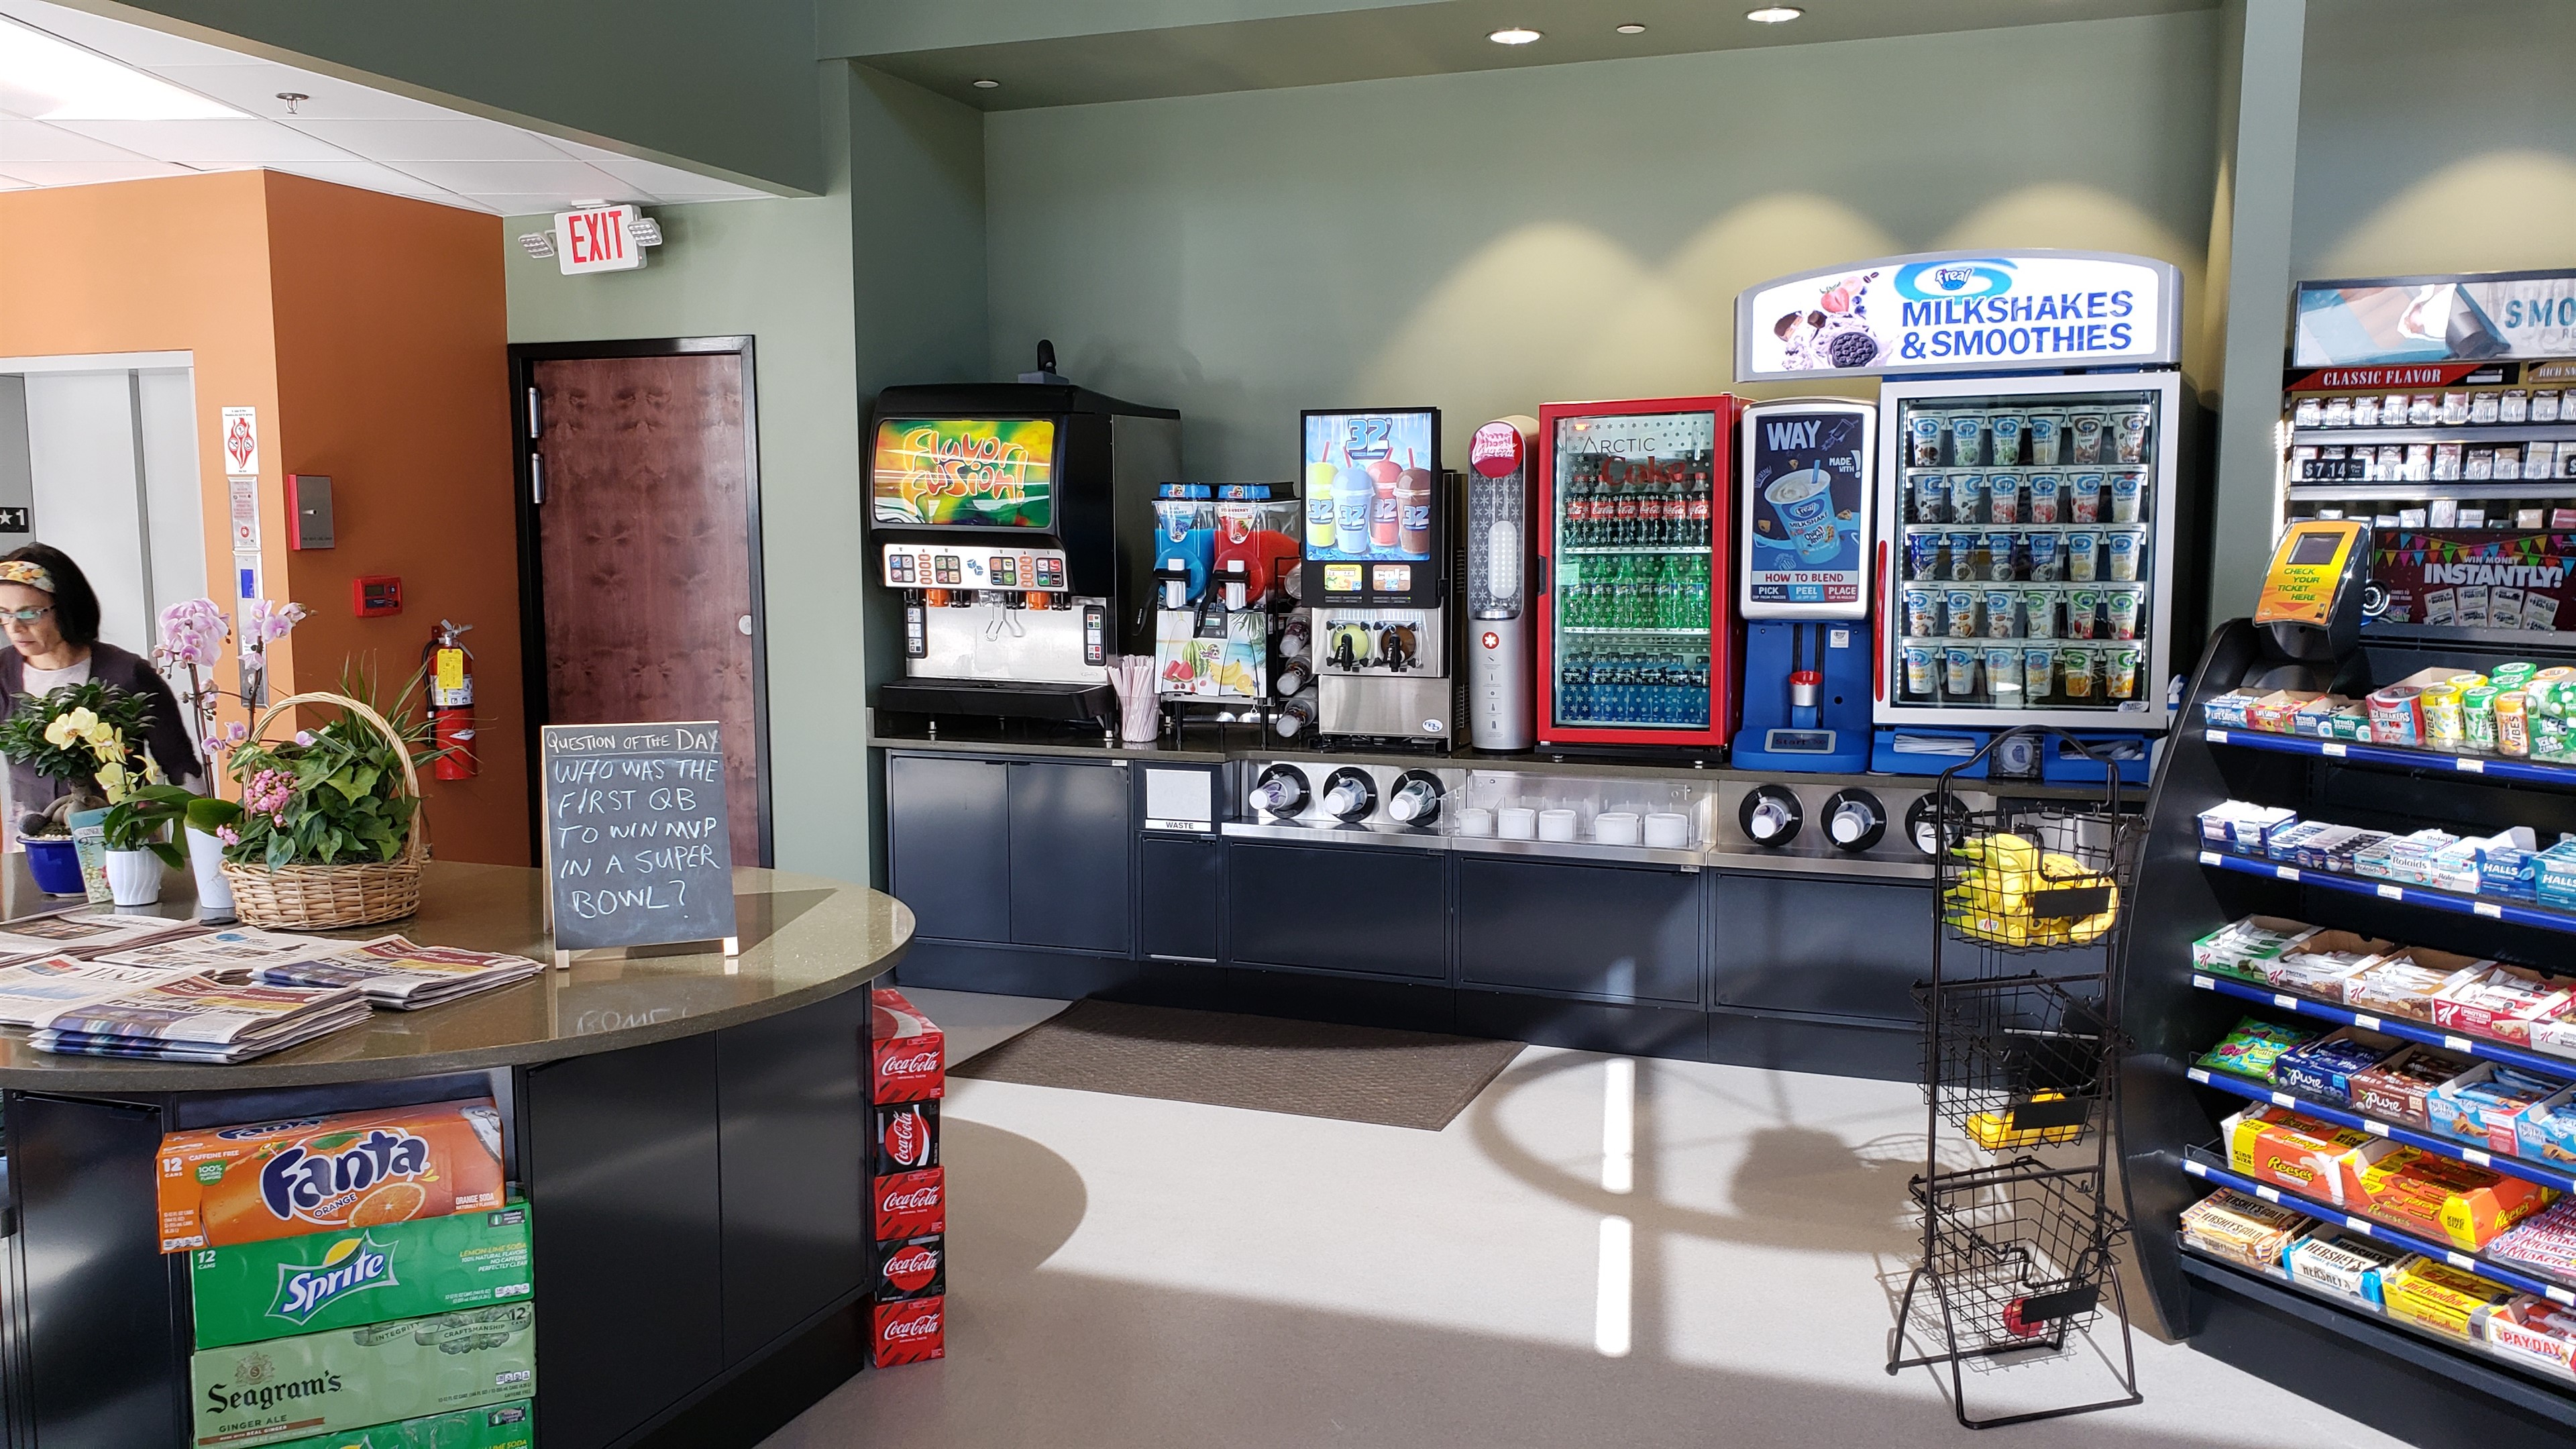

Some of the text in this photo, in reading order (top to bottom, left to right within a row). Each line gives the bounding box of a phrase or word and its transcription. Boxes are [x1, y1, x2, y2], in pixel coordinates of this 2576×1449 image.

[568, 211, 623, 263] EXIT
[1902, 290, 2133, 327] MILKSHAKES
[2323, 368, 2441, 387] CLASSIC FLAVOR
[1582, 436, 1656, 453] ARCTIC
[1766, 420, 1821, 451] WAY
[903, 429, 1025, 473] Flavor
[1601, 455, 1687, 486] Coke
[1829, 457, 1852, 466] MADE
[2305, 462, 2347, 478] $7.14
[902, 449, 1028, 517] Fusion!
[17, 509, 27, 527] 1
[1790, 511, 1829, 528] MILKSHAKE
[1766, 574, 1843, 582] HOW TO BLEND
[2424, 563, 2563, 588] INSTANTLY!
[1759, 586, 1779, 594] PICK
[1796, 586, 1817, 594] PEEL
[1829, 586, 1857, 595] PLACE
[2381, 711, 2410, 722] BREAKERS
[2425, 708, 2434, 738] VIBES
[2509, 715, 2520, 746] VIBES
[547, 729, 720, 753] QUESTION OF THE DAY
[555, 759, 719, 784] WHO WAS THE
[558, 788, 697, 818] FIRST QB
[558, 817, 717, 849] TO WIN MVP
[561, 843, 720, 879] IN A SUPER
[2356, 863, 2380, 873] Rolaids
[2392, 856, 2427, 869] Rolaids
[2483, 862, 2518, 875] HALLS
[572, 879, 690, 919] BOWL?
[2463, 1008, 2489, 1020] PROTEIN
[882, 1051, 940, 1076] Coca-Cola
[894, 1110, 914, 1166] Coca-Cola
[163, 1157, 182, 1172] 12
[189, 1152, 223, 1161] CAFFEINE
[198, 1164, 223, 1173] 100%
[260, 1130, 429, 1220] Fanta
[2267, 1155, 2313, 1182] Reese's
[313, 1192, 358, 1218] ORANGE
[455, 1193, 494, 1205] ORANGE SODA
[883, 1186, 941, 1212] Coca-Cola
[2261, 1208, 2286, 1222] GOLD
[2447, 1215, 2465, 1224] KING
[2494, 1201, 2530, 1230] Reese's
[2239, 1224, 2264, 1240] GOLD
[198, 1250, 215, 1264] 12
[460, 1242, 527, 1258] LEMON-LIME SODA
[476, 1252, 501, 1261] NATURAL
[502, 1248, 527, 1256] FLAVORS
[501, 1254, 527, 1263] CAFFEINE
[2304, 1242, 2367, 1271] HERSHEY'S
[478, 1263, 508, 1272] PERFECTLY
[883, 1250, 941, 1277] Coca-Cola
[282, 1248, 385, 1314] Sprite
[509, 1307, 526, 1321] 12
[376, 1321, 421, 1342] INTEGRITY
[443, 1324, 506, 1338] CRAFTSMANSHIP
[883, 1313, 941, 1340] Coca-Cola
[2503, 1331, 2562, 1356] PAYDAY
[206, 1369, 341, 1413] Seagram's
[219, 1414, 287, 1432] GINGER ALE
[264, 1425, 288, 1433] GINGER
